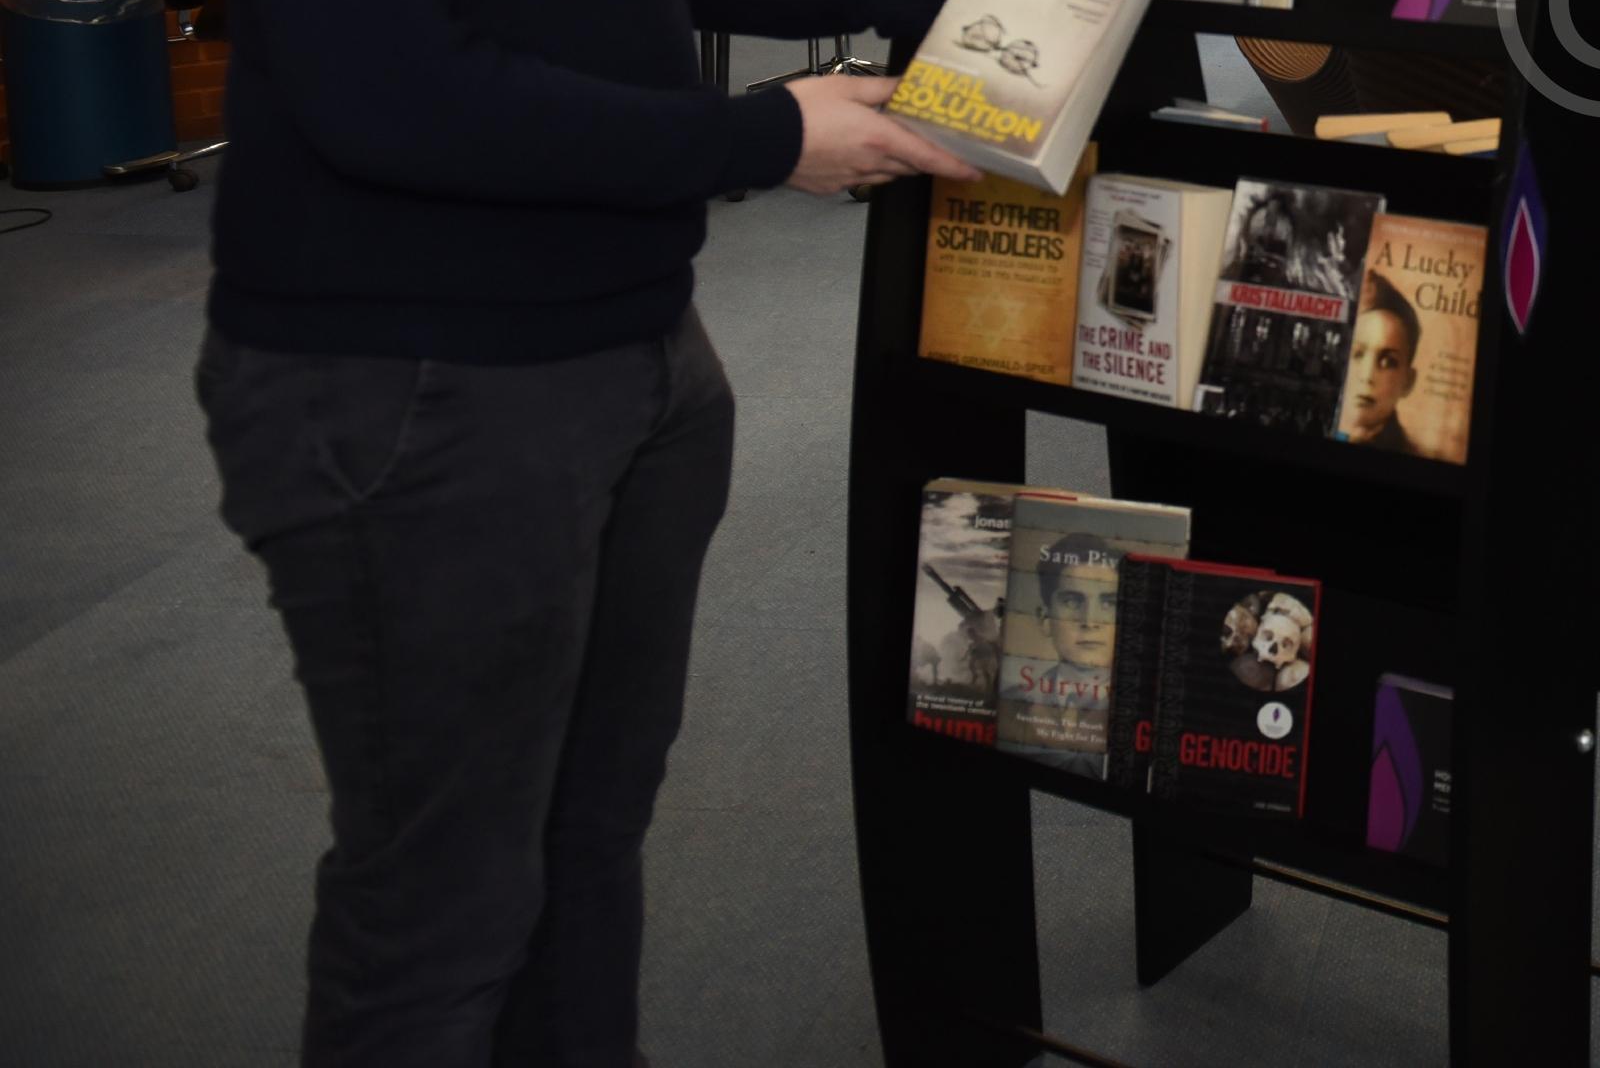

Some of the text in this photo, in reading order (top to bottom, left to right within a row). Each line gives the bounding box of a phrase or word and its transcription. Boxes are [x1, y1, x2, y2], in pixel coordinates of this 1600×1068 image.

[903, 59, 987, 103] FINAL
[892, 81, 1043, 143] SOLUTION
[946, 197, 1060, 232] THE OTHER
[936, 224, 1064, 261] SCHINDLERS
[1375, 241, 1475, 287] A Lucky
[1415, 282, 1484, 319] Child
[1079, 324, 1171, 360] THE CRIME AND
[1082, 350, 1165, 385] THE SILENCE
[1040, 546, 1080, 567] Sam
[1180, 731, 1297, 779] GENOCIDE
